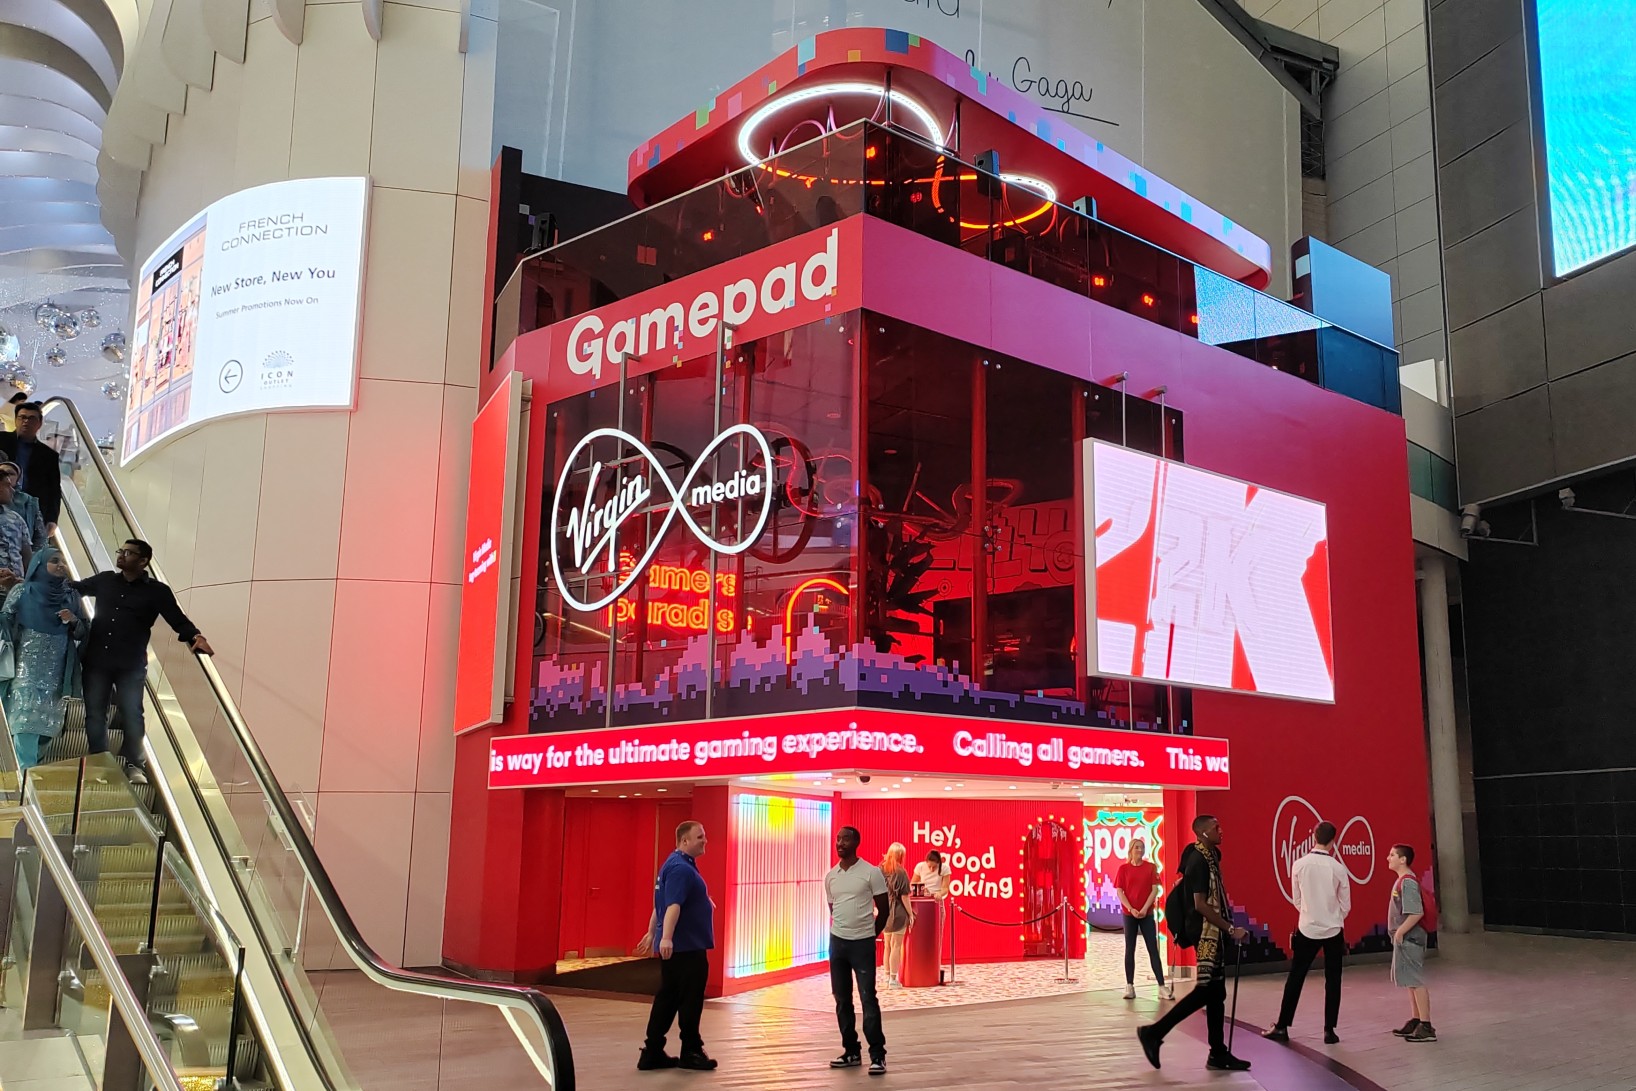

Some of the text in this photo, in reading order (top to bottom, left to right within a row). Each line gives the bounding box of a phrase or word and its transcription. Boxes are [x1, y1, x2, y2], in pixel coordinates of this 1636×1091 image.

[1012, 56, 1093, 113] Gaga
[238, 212, 305, 233] FRENCH
[221, 224, 329, 252] CONNECTION
[210, 267, 336, 298] New Store, New You
[215, 296, 319, 319] Summer Promotions Now On
[566, 227, 839, 379] Gamepad
[260, 370, 294, 380] ICON
[566, 461, 651, 575] Virgin
[691, 469, 761, 507] media
[506, 752, 543, 775] way
[546, 745, 572, 768] for
[574, 743, 605, 766] the
[608, 738, 690, 765] ultimate
[694, 730, 777, 766] gaming
[782, 721, 924, 759] experience.
[953, 730, 1033, 767] Calling
[1036, 737, 1064, 762] all
[1067, 745, 1145, 769] gamers.
[1165, 746, 1203, 771] This
[913, 820, 962, 850] Hey,
[1342, 840, 1371, 855] media
